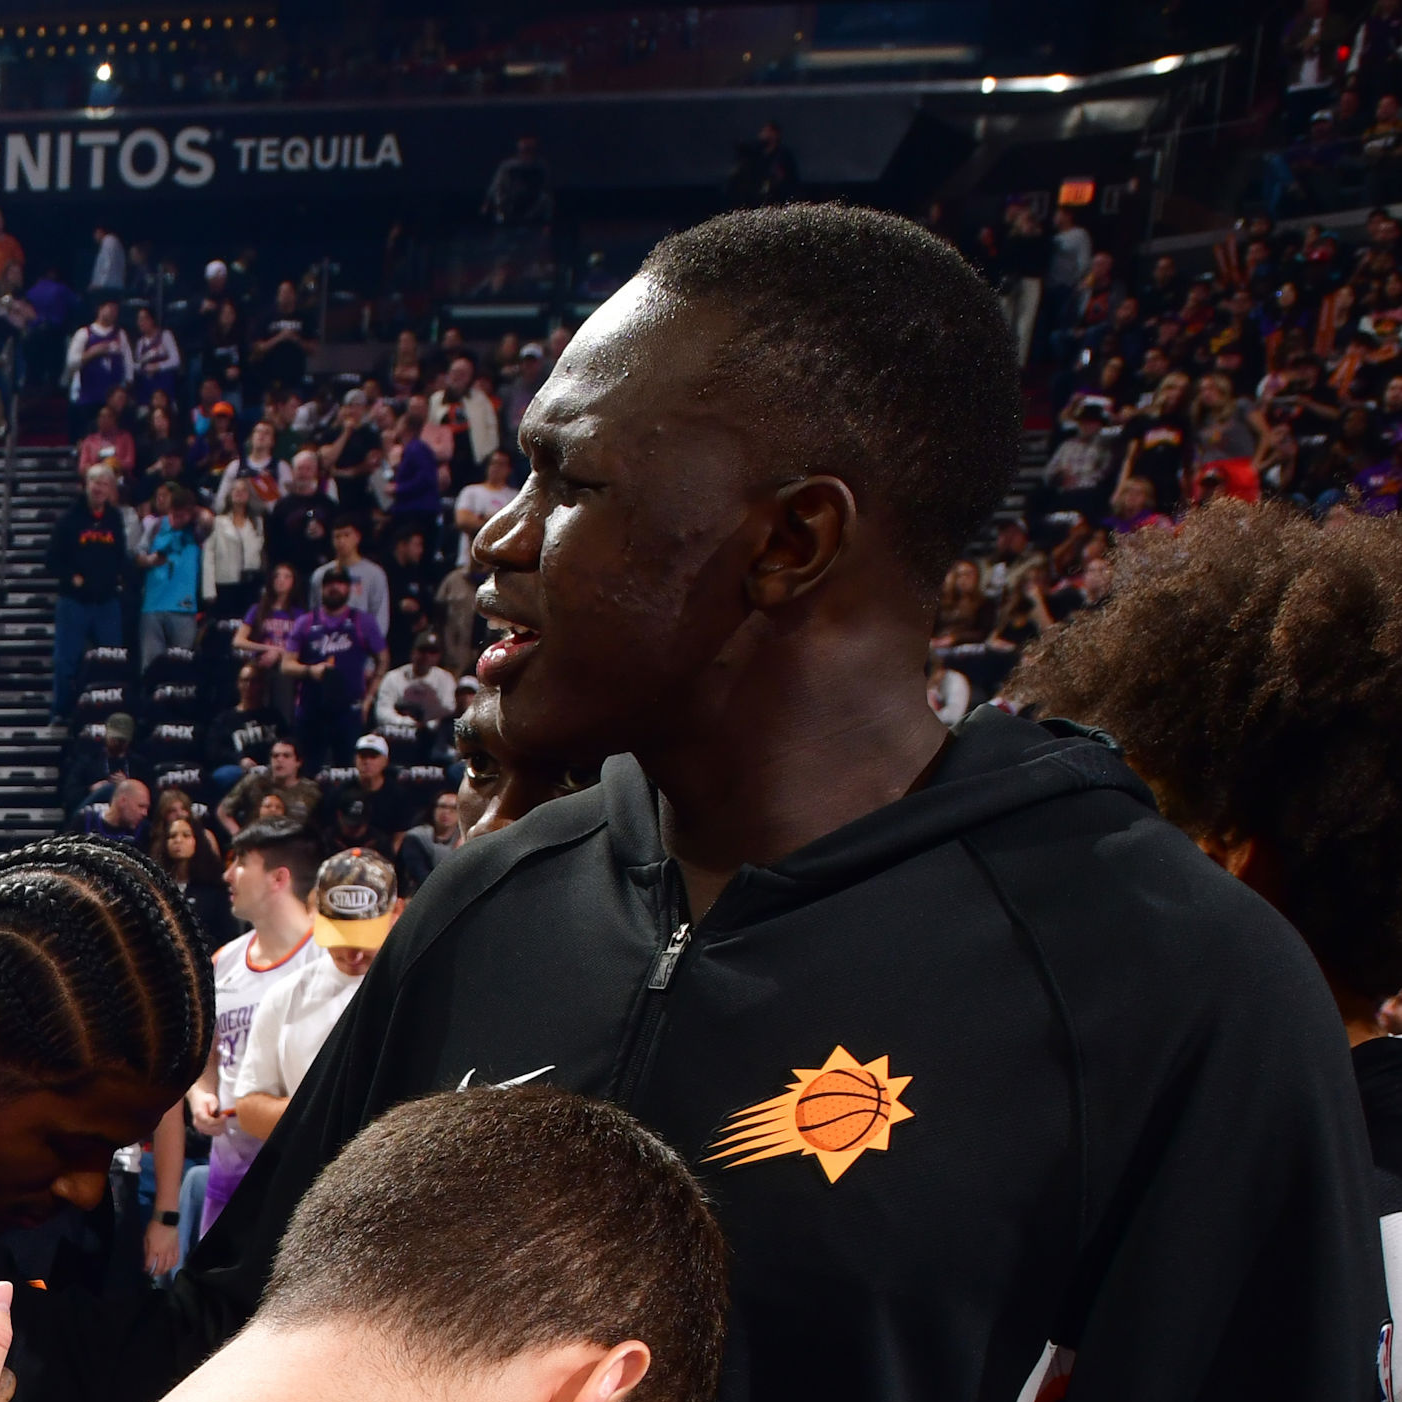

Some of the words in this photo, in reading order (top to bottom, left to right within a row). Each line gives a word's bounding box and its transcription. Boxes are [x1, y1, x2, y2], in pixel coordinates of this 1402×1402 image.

[233, 133, 402, 172] TEQUILA
[97, 647, 128, 661] PHX
[91, 688, 123, 702] PHX
[162, 724, 194, 740] PHX
[168, 768, 201, 784] PHX
